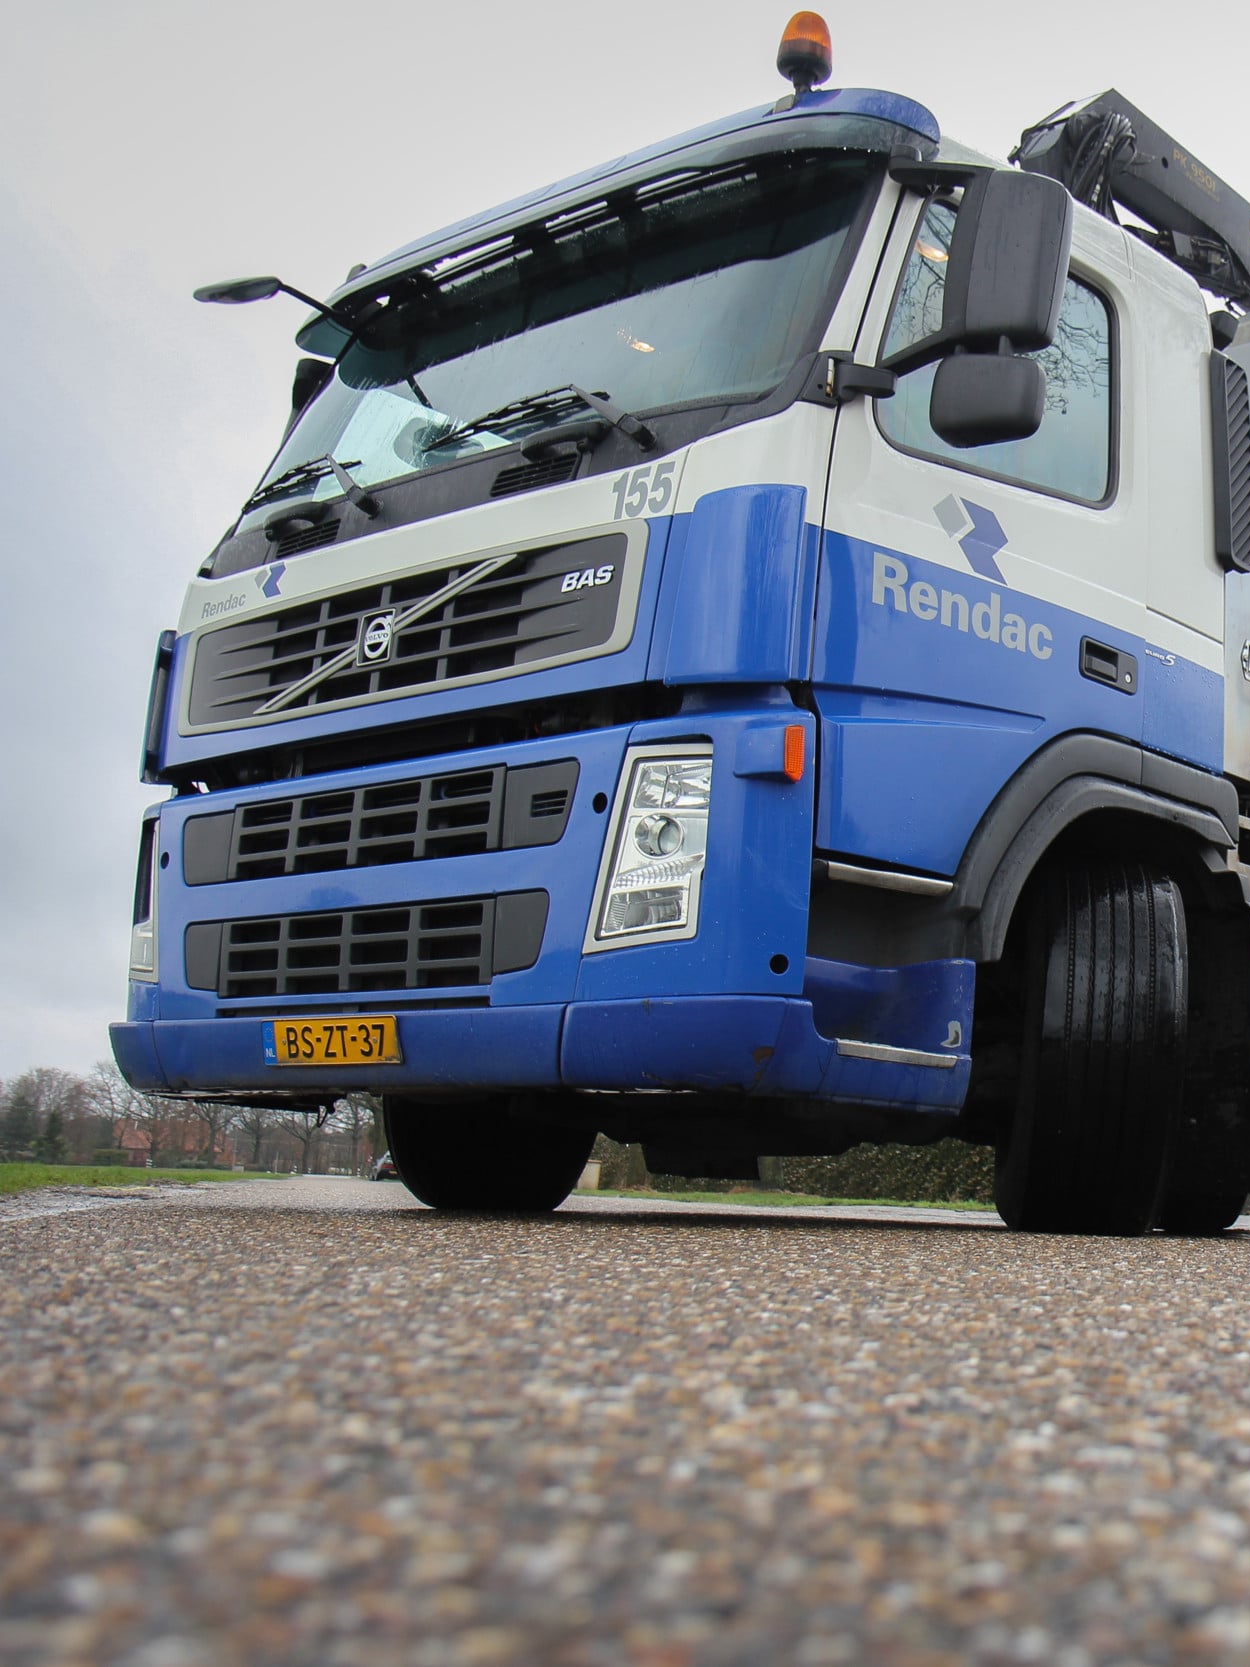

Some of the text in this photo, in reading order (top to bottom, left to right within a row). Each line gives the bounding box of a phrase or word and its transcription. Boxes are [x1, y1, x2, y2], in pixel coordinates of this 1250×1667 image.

[1173, 148, 1188, 168] PK
[612, 461, 676, 520] 155
[561, 565, 615, 593] BAS
[201, 593, 246, 619] Rendac
[872, 552, 1052, 660] Rendac
[265, 1047, 276, 1058] NL
[286, 1023, 385, 1059] BS-ZT-37
